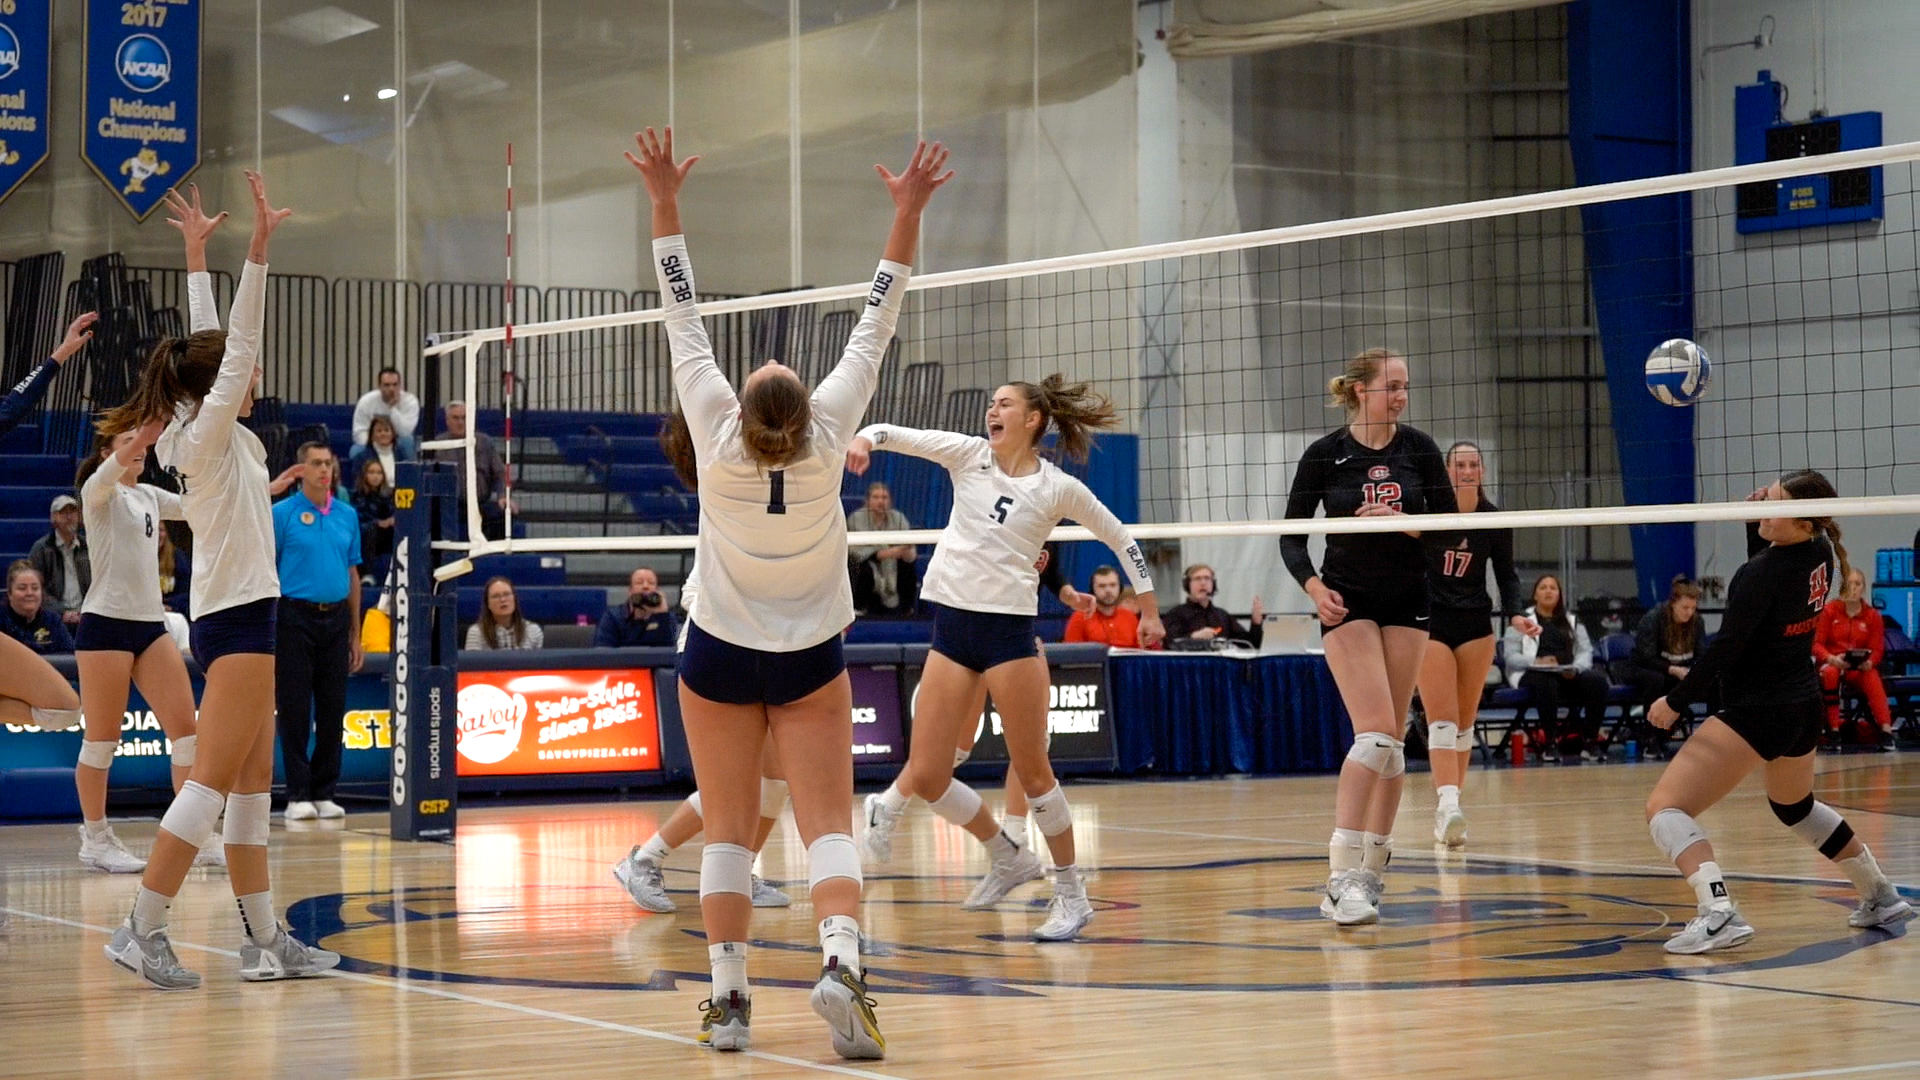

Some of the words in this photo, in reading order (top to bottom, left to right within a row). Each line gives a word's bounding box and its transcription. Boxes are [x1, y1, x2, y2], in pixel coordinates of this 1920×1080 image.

[121, 2, 167, 28] 2017
[122, 60, 168, 79] NCAA
[109, 97, 176, 121] National
[98, 116, 186, 145] Champions
[660, 254, 692, 303] BEARS
[767, 469, 786, 514] 1
[1361, 482, 1402, 512] 12
[989, 495, 1014, 525] 5
[144, 512, 154, 538] 8
[1443, 550, 1473, 578] 17
[1807, 561, 1829, 612] 4
[392, 536, 409, 806] CONCORDIA
[429, 687, 441, 728] sports
[1060, 685, 1098, 708] FAST
[428, 729, 441, 780] imports
[419, 799, 450, 815] CSP
